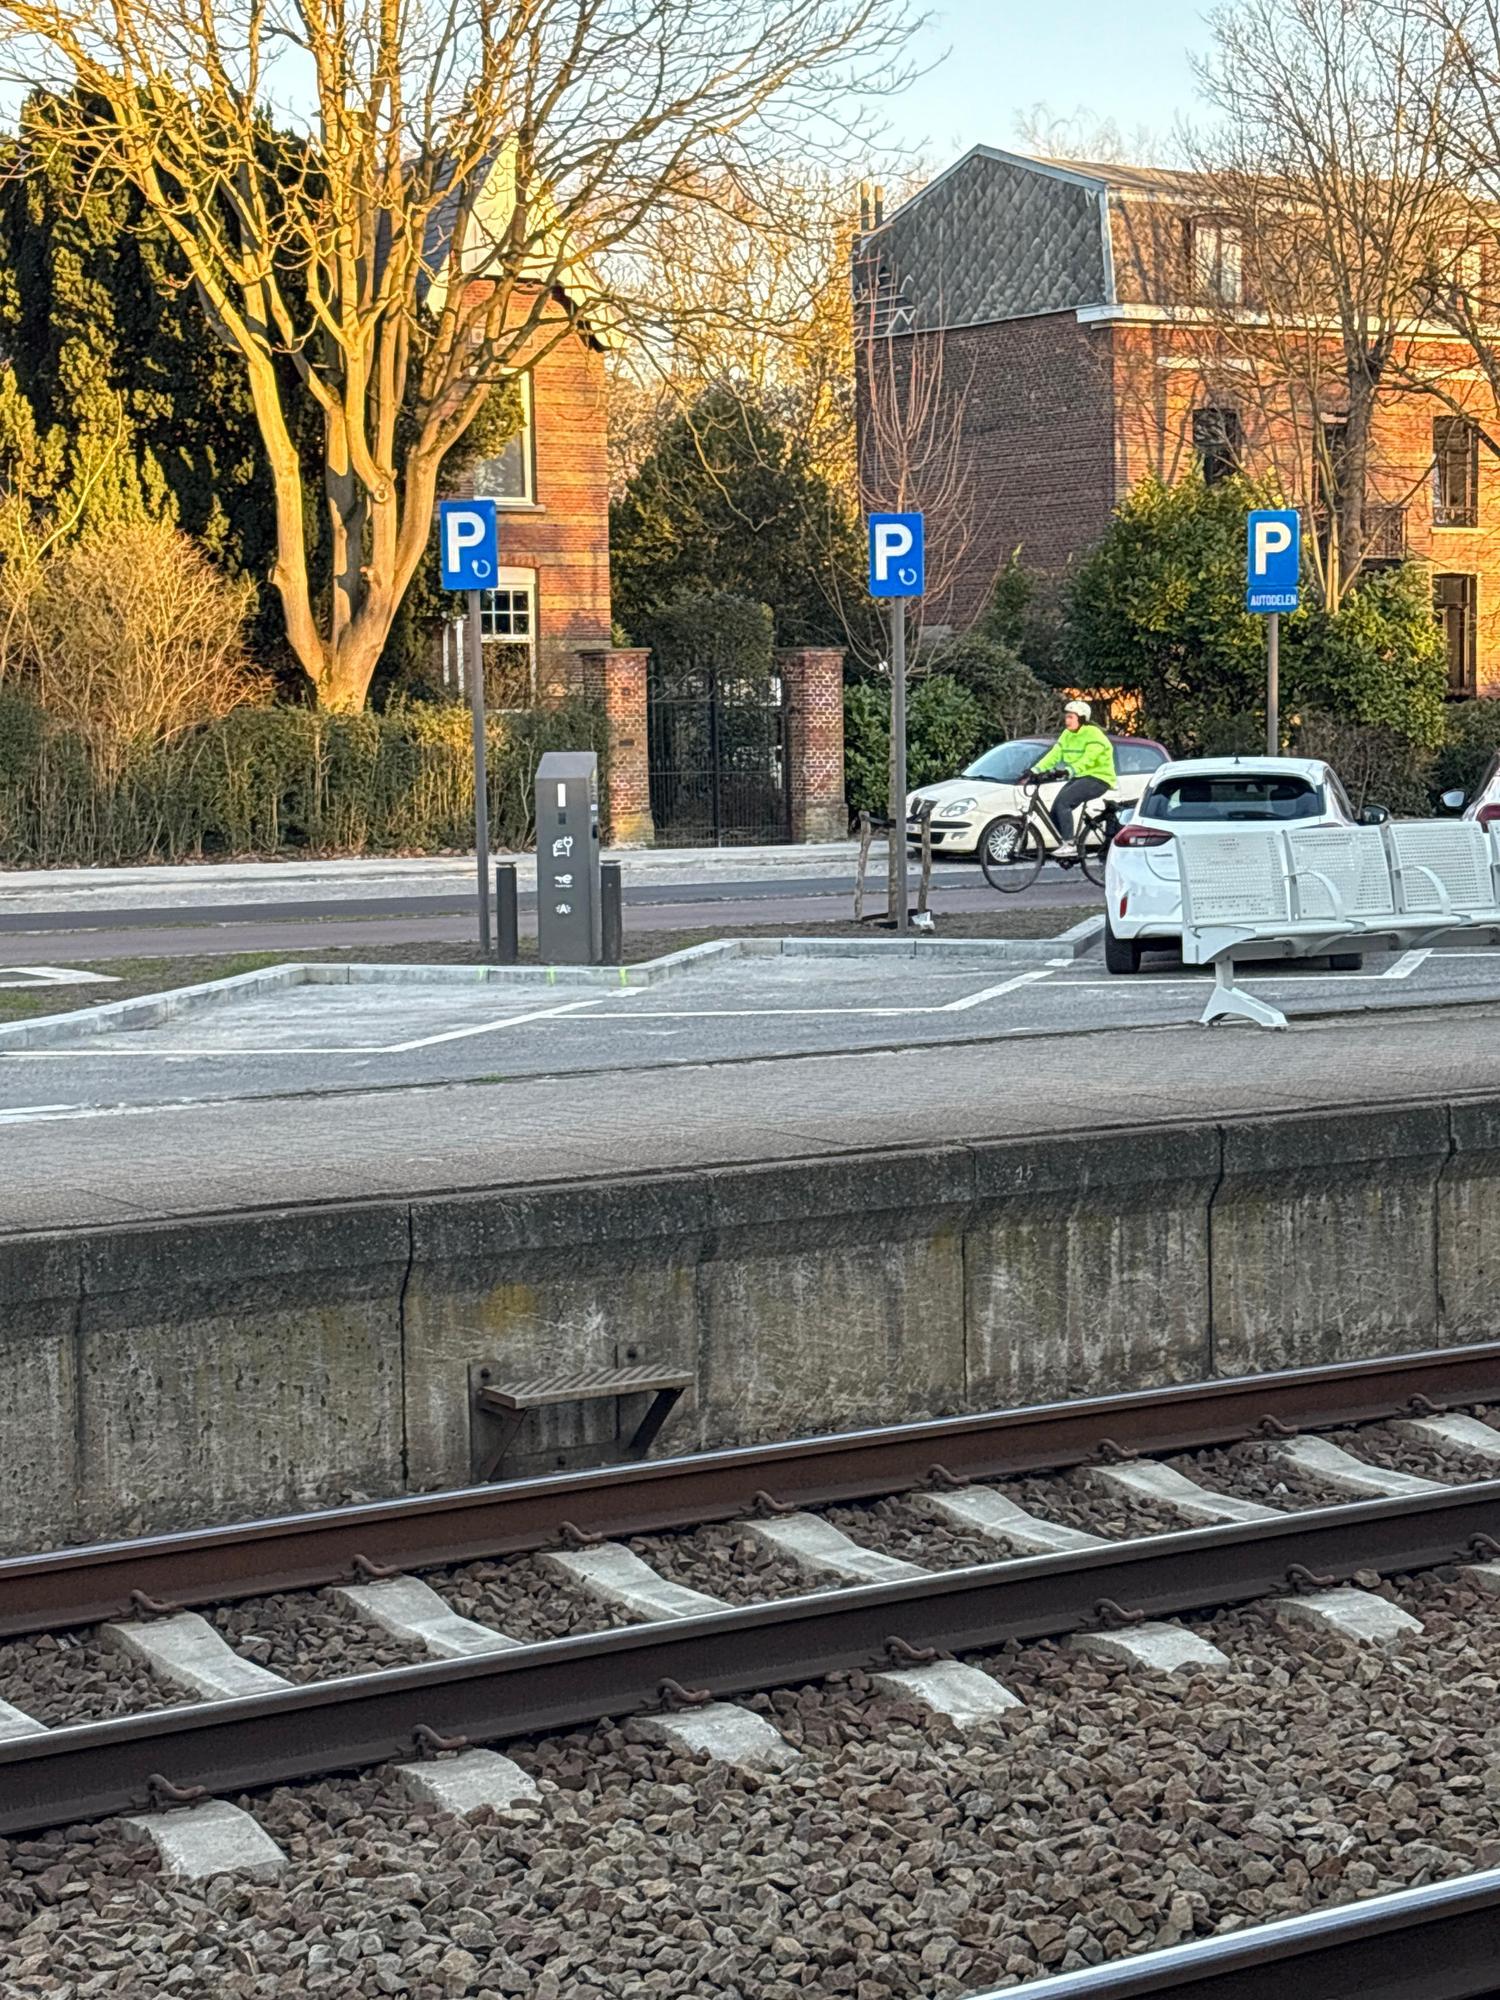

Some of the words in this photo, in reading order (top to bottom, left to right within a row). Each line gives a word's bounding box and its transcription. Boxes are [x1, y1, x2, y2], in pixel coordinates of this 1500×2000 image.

[446, 511, 486, 573] P
[875, 523, 913, 581] P
[1255, 522, 1292, 575] P
[1250, 594, 1297, 606] AUTODELEN
